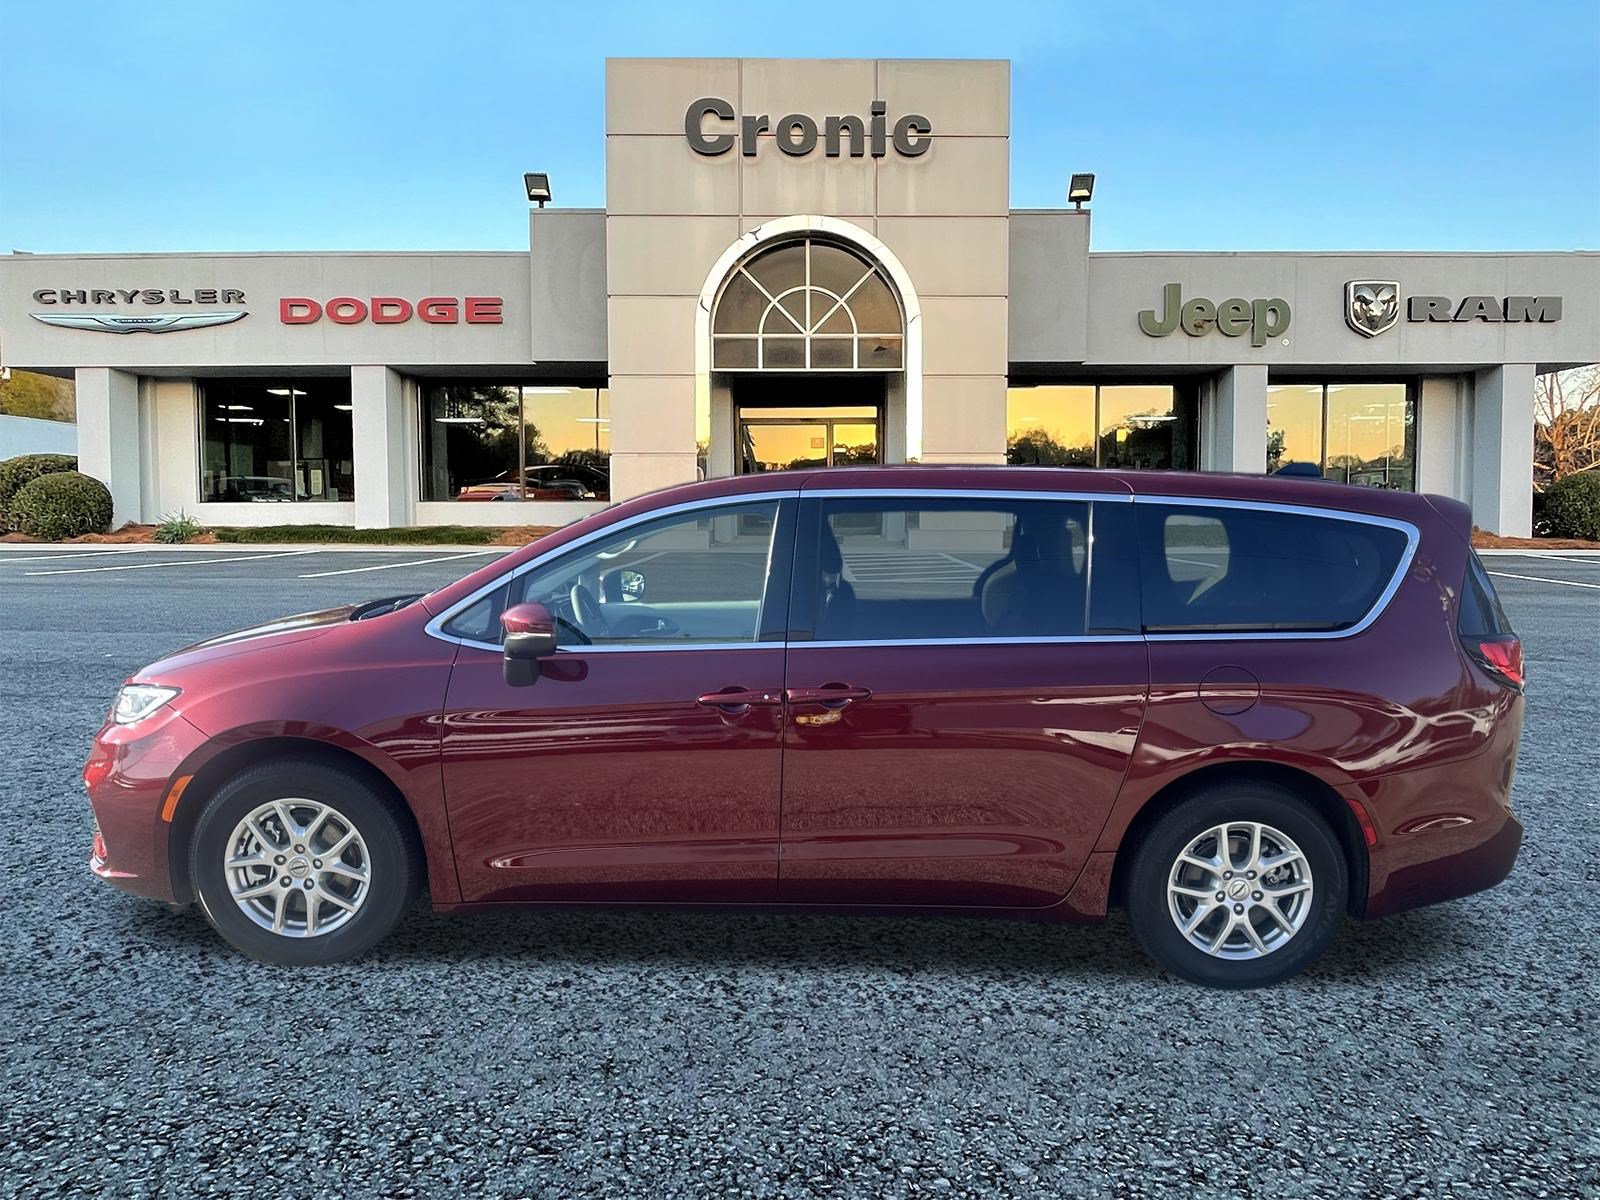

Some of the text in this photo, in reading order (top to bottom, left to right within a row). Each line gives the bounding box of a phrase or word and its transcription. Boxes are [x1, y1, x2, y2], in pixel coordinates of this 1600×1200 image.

[685, 97, 931, 157] Cronic
[32, 289, 246, 304] CHRYSLER
[1407, 296, 1563, 322] RAM
[280, 297, 503, 324] DODGE
[1138, 283, 1291, 347] Jeep
